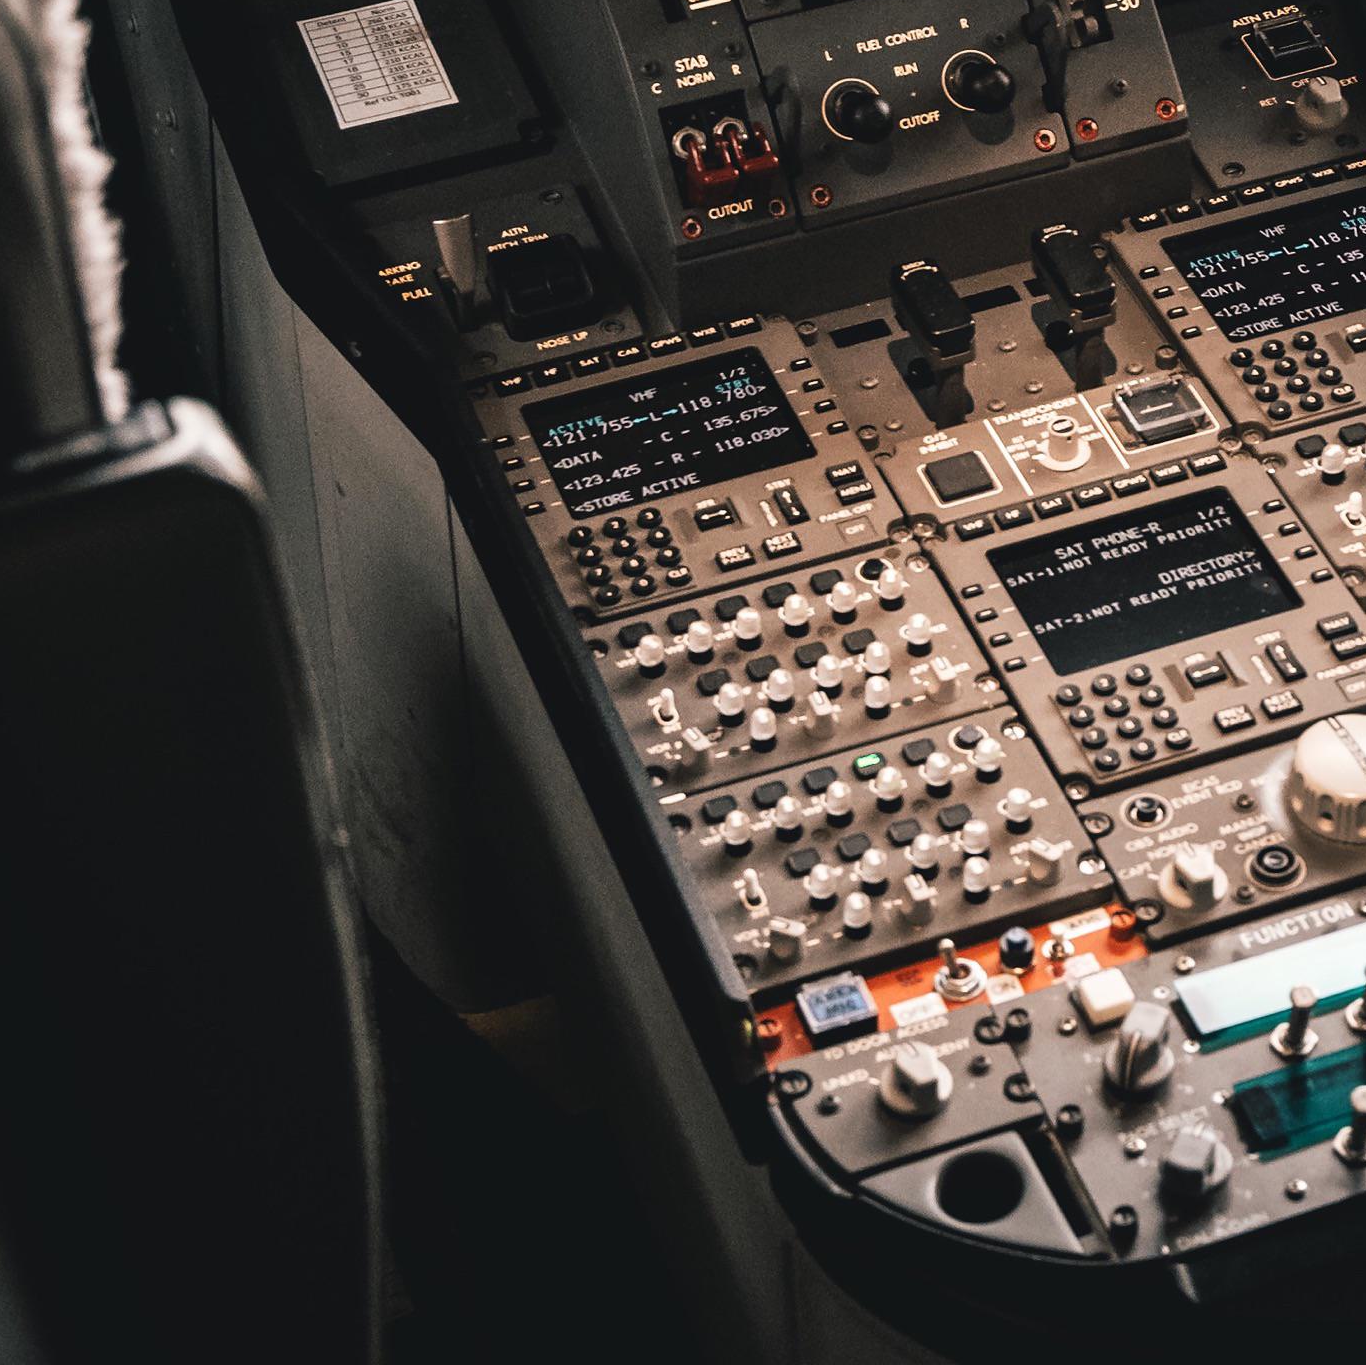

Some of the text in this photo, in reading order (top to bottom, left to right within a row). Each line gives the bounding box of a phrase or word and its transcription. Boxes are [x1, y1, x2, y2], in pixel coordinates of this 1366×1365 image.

[1232, 4, 1300, 29] ALTN FLAPS
[856, 26, 938, 54] FUEL CONTROL
[675, 55, 709, 72] STAB
[894, 63, 919, 78] RUN
[676, 71, 715, 88] NORM
[898, 111, 940, 130] CUTOFF
[708, 198, 754, 220] CUTOUT
[1260, 224, 1287, 238] VHF
[1289, 301, 1344, 323] ACTIVE
[536, 332, 588, 351] NOSE UP
[719, 367, 747, 380] 1/2
[628, 388, 658, 404] VHF
[1055, 521, 1164, 560] SAT PHONE-R
[1101, 541, 1150, 560] READY
[1157, 517, 1234, 545] PRIORITY
[1130, 587, 1179, 607] READY
[1186, 561, 1264, 591] PRIORITY
[1238, 900, 1356, 949] FUNCTION
